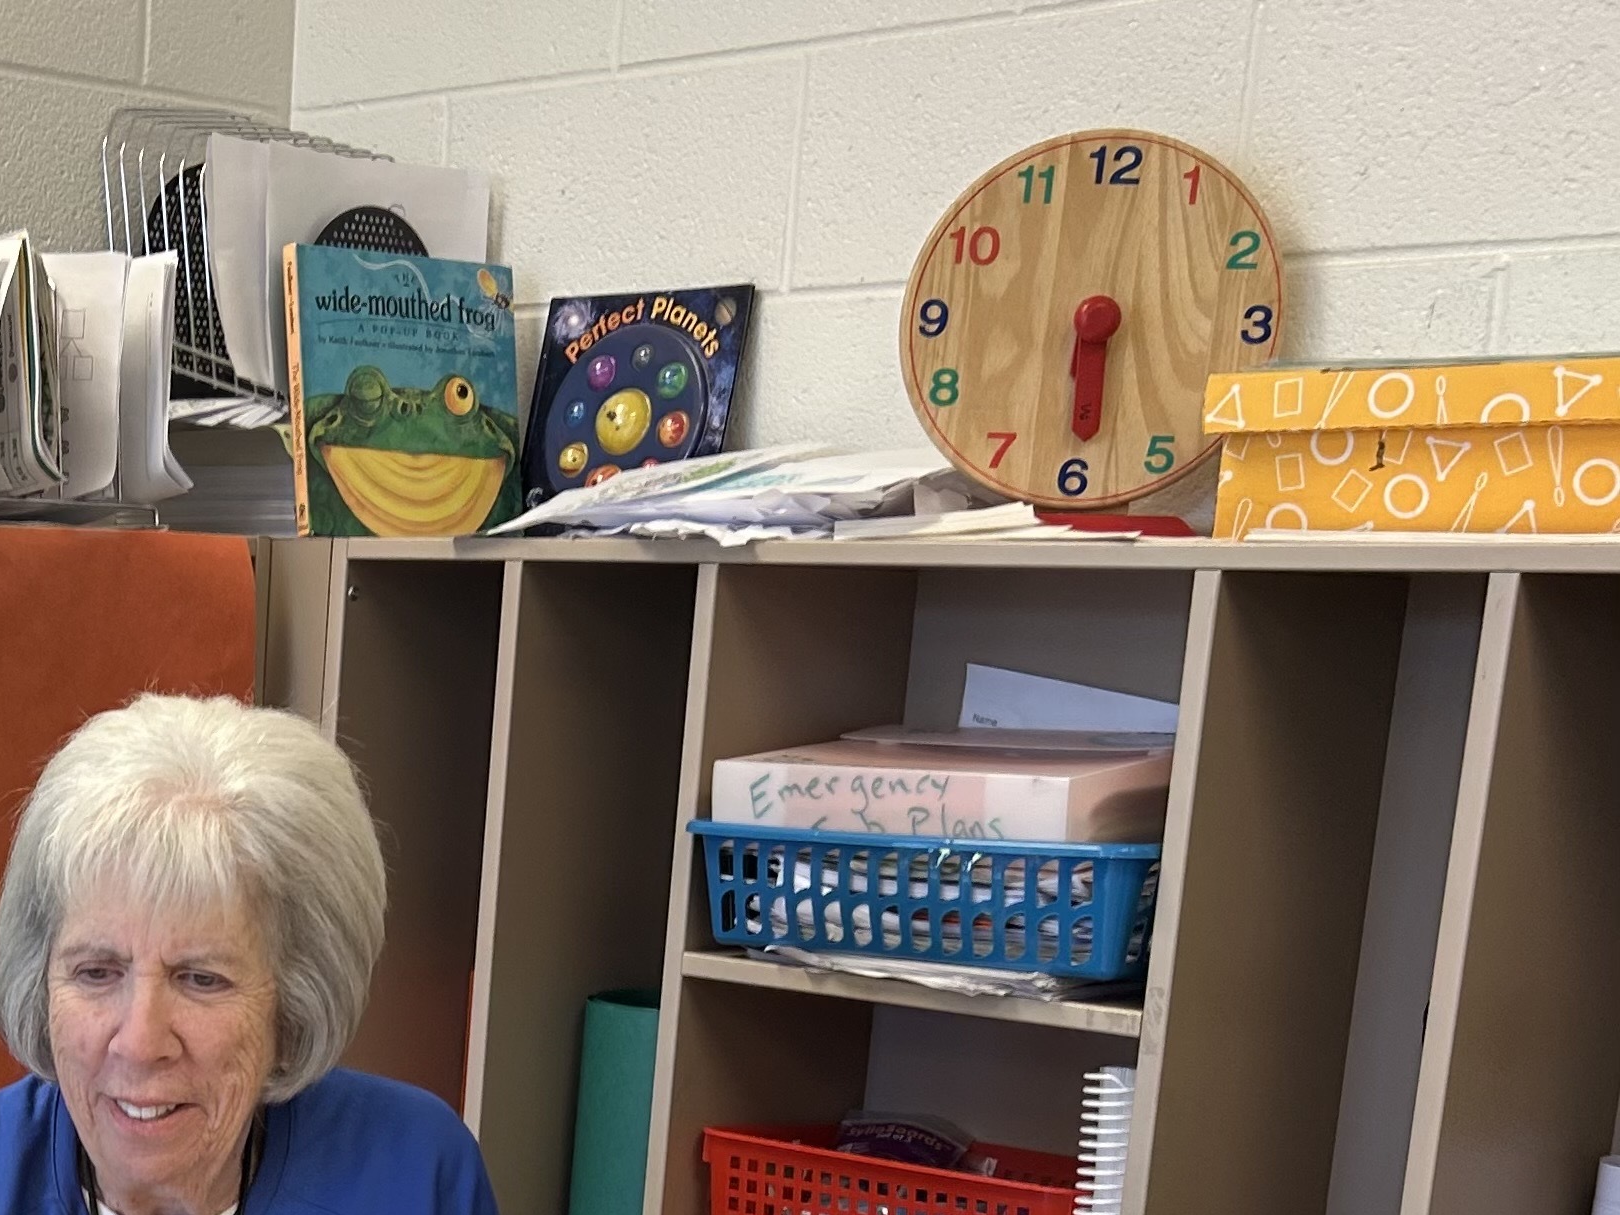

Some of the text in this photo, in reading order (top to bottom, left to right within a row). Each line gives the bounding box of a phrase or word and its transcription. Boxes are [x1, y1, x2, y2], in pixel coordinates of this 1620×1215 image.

[1090, 146, 1143, 185] 12
[1018, 166, 1055, 204] 11
[1183, 166, 1200, 204] 1
[949, 226, 1000, 265] 10
[1226, 231, 1260, 269] 2
[315, 286, 495, 331] wide-mouthed frog
[919, 299, 948, 338] 9
[1241, 305, 1272, 344] 3
[358, 324, 458, 341] A POP-UP BOOK
[565, 296, 721, 365] Perfect Planets
[929, 368, 959, 406] 8
[987, 432, 1017, 468] 7
[1144, 436, 1174, 474] 5
[1058, 459, 1088, 496] 6
[972, 713, 998, 726] Name
[749, 772, 950, 819] Emergency
[907, 804, 1005, 840] Plans
